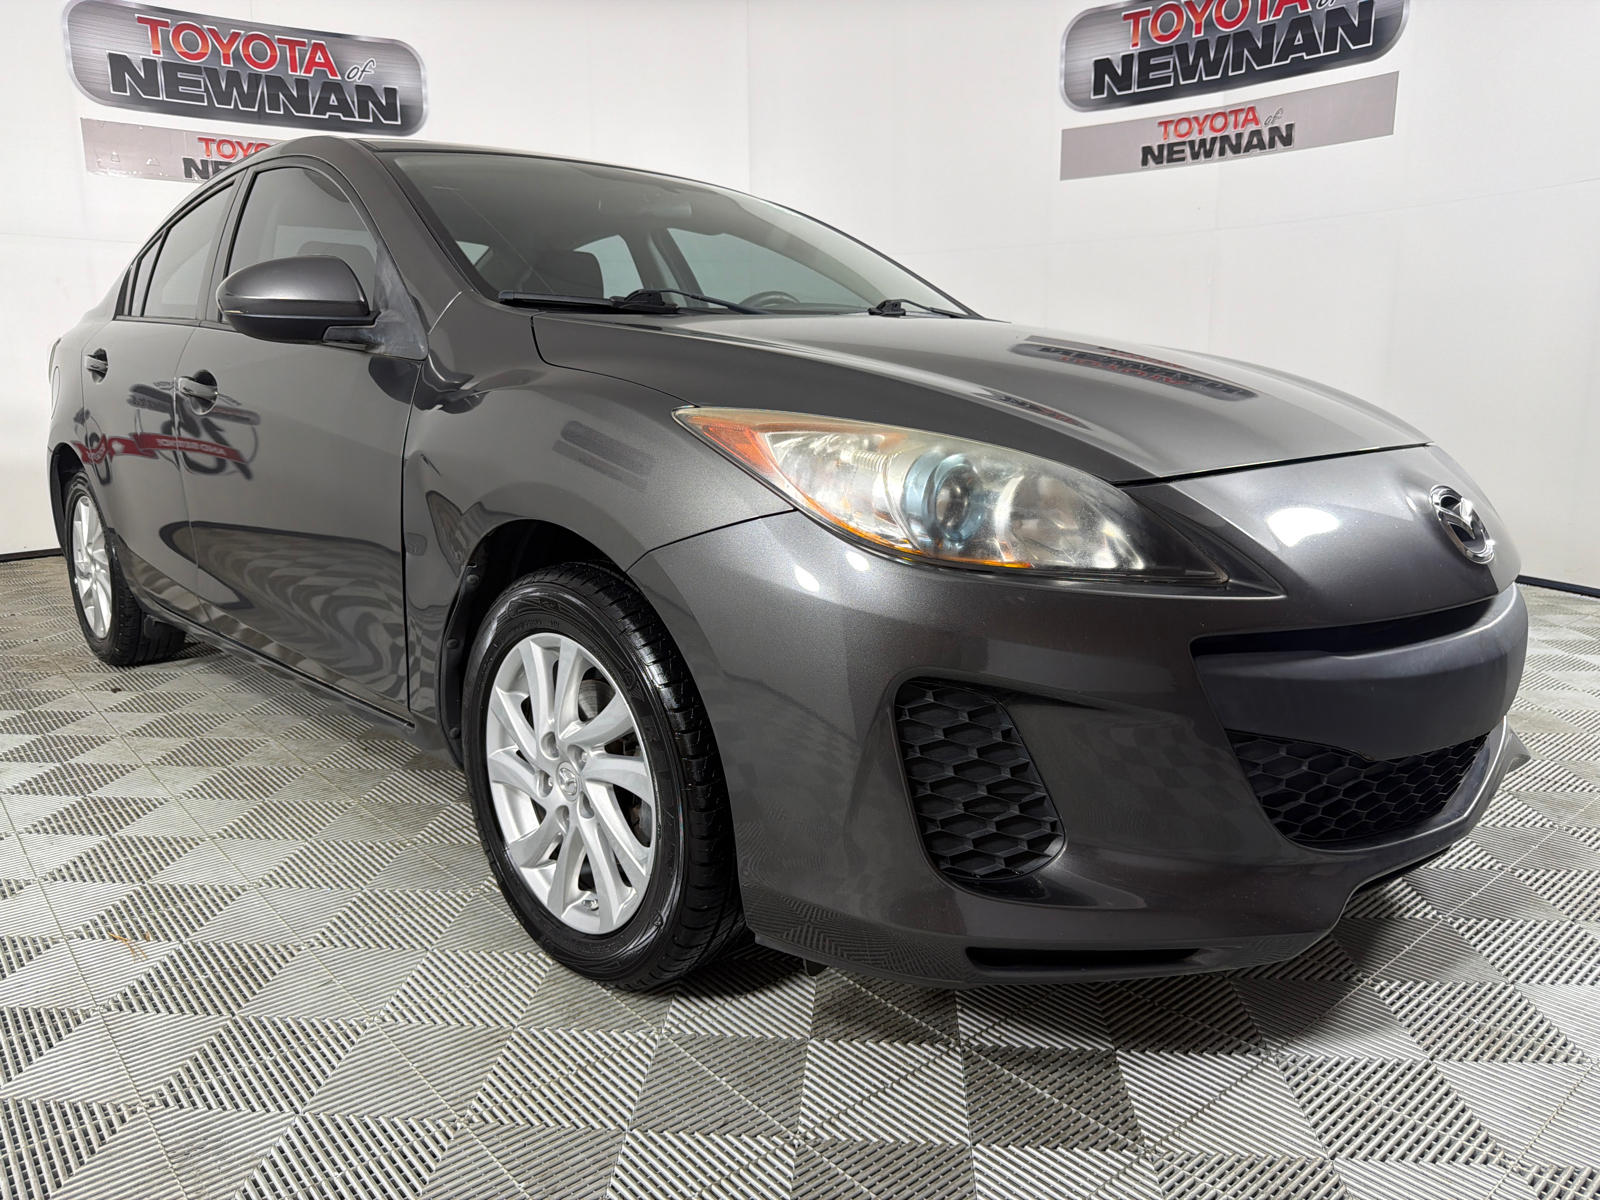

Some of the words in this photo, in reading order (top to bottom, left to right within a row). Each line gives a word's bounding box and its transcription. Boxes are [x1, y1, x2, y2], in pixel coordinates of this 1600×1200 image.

[135, 15, 341, 79] TOYOTA
[346, 58, 376, 81] of
[1092, 0, 1374, 98] NEWNAN
[107, 52, 401, 124] NEWNAN
[197, 136, 271, 160] TOY
[1141, 123, 1295, 167] NEWNAN
[1158, 105, 1260, 141] TOYOTA
[1264, 107, 1284, 126] of
